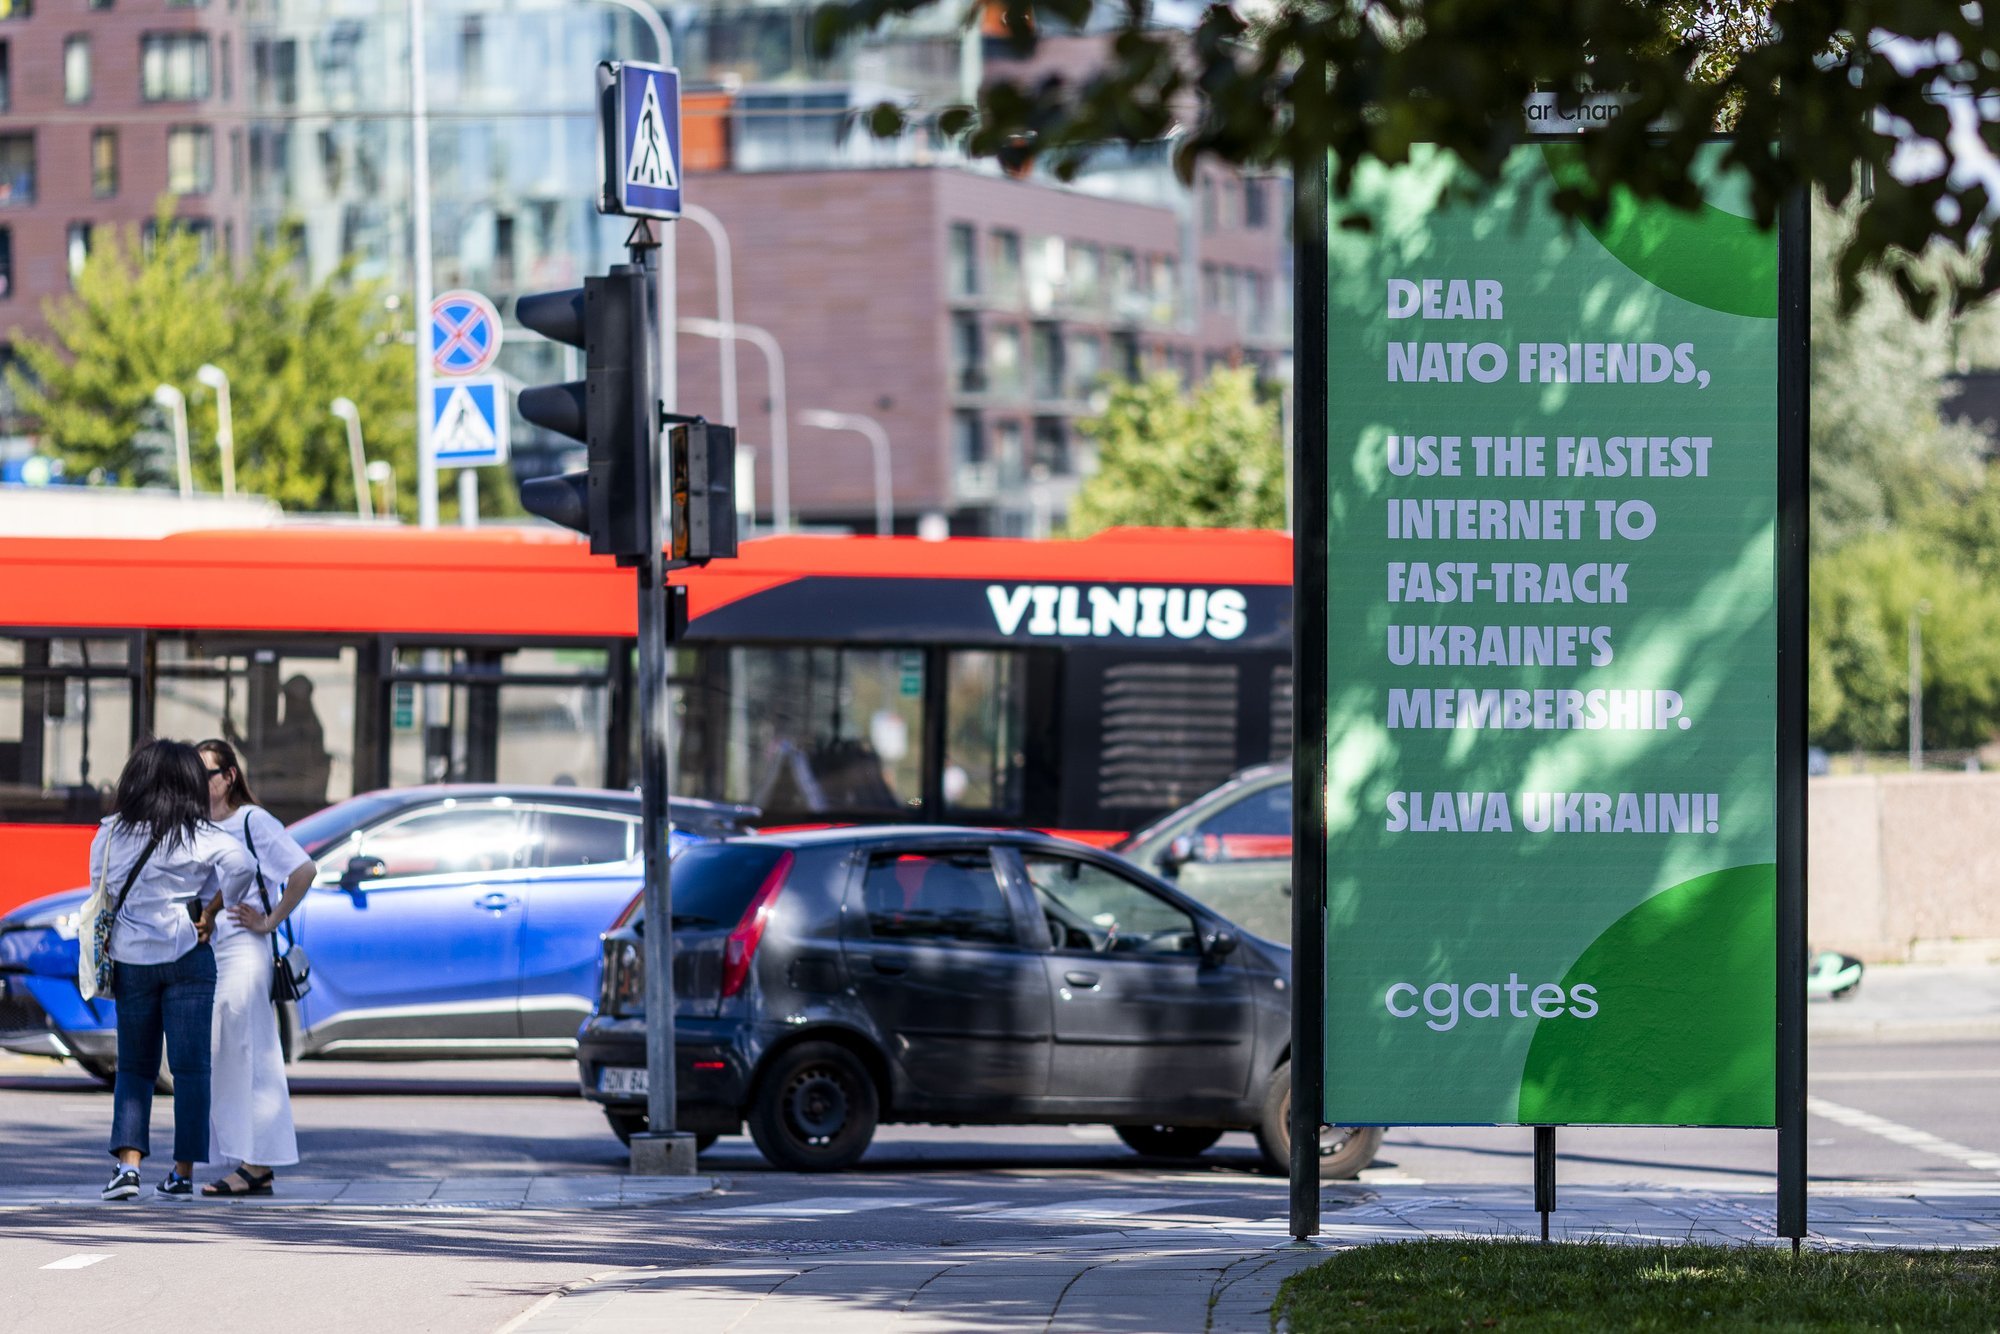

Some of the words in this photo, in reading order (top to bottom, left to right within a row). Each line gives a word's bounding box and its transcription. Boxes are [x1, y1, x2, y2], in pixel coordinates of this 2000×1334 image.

[1387, 278, 1504, 320] DEAR
[1387, 342, 1508, 383] NATO
[1518, 342, 1711, 389] FRIENDS,
[1387, 435, 1462, 477] USE
[1471, 436, 1546, 477] THE
[1556, 436, 1713, 478] FASTEST
[1387, 499, 1586, 540] INTERNET
[1595, 499, 1657, 541] TO
[1387, 562, 1630, 604] FAST-TRACK
[986, 585, 1247, 640] VILNIUS
[1387, 625, 1614, 667] UKRAINE'S
[1386, 688, 1692, 730] MEMBERSHIP.
[1385, 791, 1513, 832] SLAVA
[1522, 792, 1720, 834] UKRAINI!
[1385, 973, 1600, 1032] cgates
